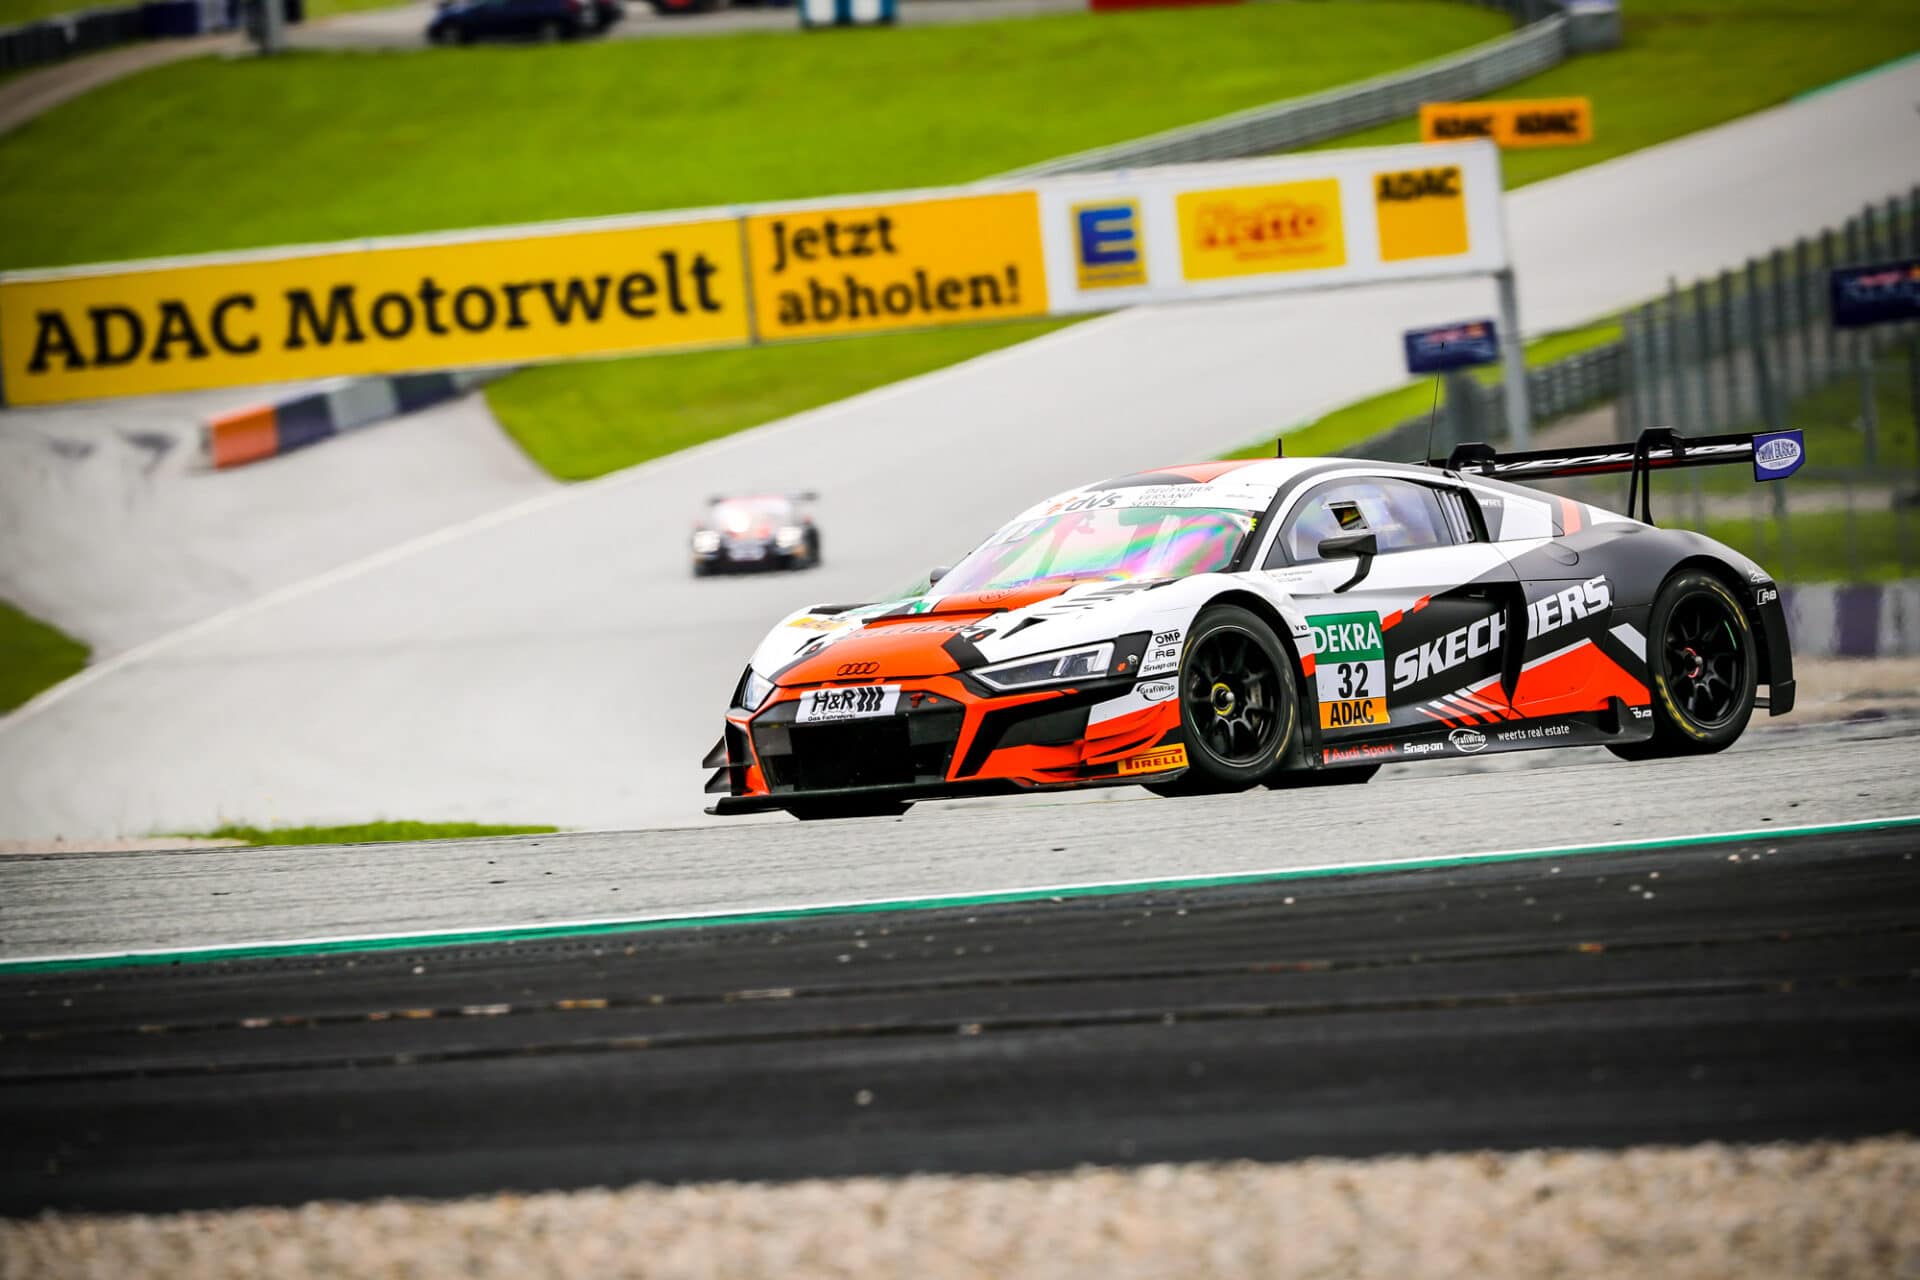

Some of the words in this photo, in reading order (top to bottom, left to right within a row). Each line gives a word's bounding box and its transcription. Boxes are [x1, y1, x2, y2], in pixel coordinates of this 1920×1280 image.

[1377, 166, 1460, 201] ADAC
[770, 213, 896, 272] Jetzt
[778, 265, 1020, 326] abholen!
[28, 295, 261, 374] ADAC
[284, 251, 722, 349] Motorwelt
[1155, 632, 1181, 645] OMP
[1311, 622, 1382, 654] DEKRA
[1155, 648, 1176, 660] R8
[1337, 662, 1369, 698] 32
[811, 690, 856, 712] H&R
[1330, 700, 1374, 726] ADAC
[1497, 729, 1526, 741] weerts
[1527, 727, 1544, 739] real
[1545, 723, 1570, 736] estate
[1125, 747, 1184, 769] PIRELLI
[1332, 745, 1361, 761] Audi
[1362, 743, 1396, 760] Sport
